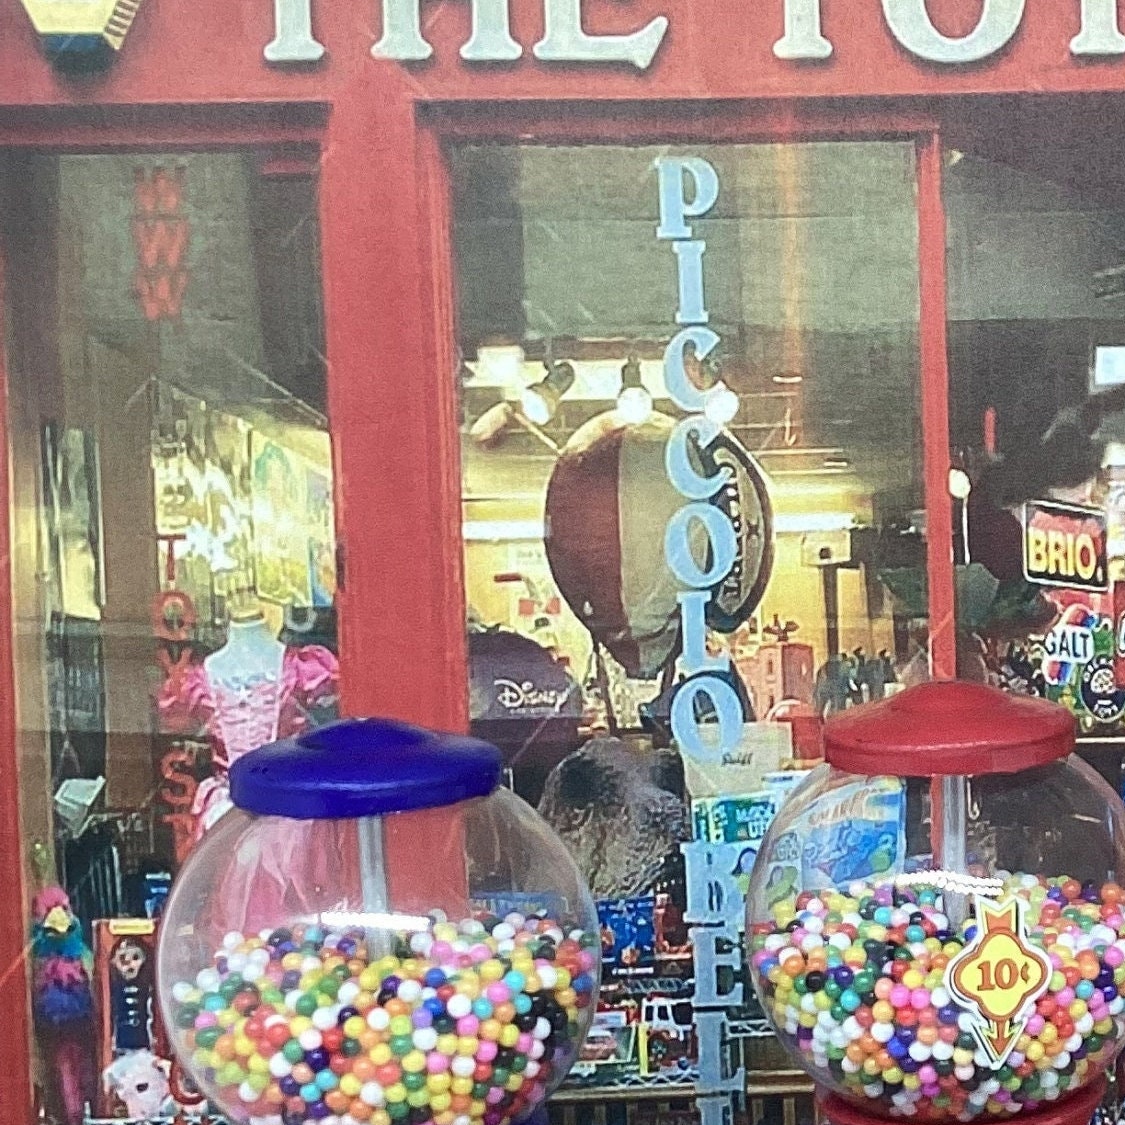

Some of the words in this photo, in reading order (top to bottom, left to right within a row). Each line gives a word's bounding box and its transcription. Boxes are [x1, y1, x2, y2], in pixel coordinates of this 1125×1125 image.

[653, 156, 744, 767] PICCOLO
[1044, 631, 1090, 659] GALT
[976, 957, 1030, 992] 10¢
